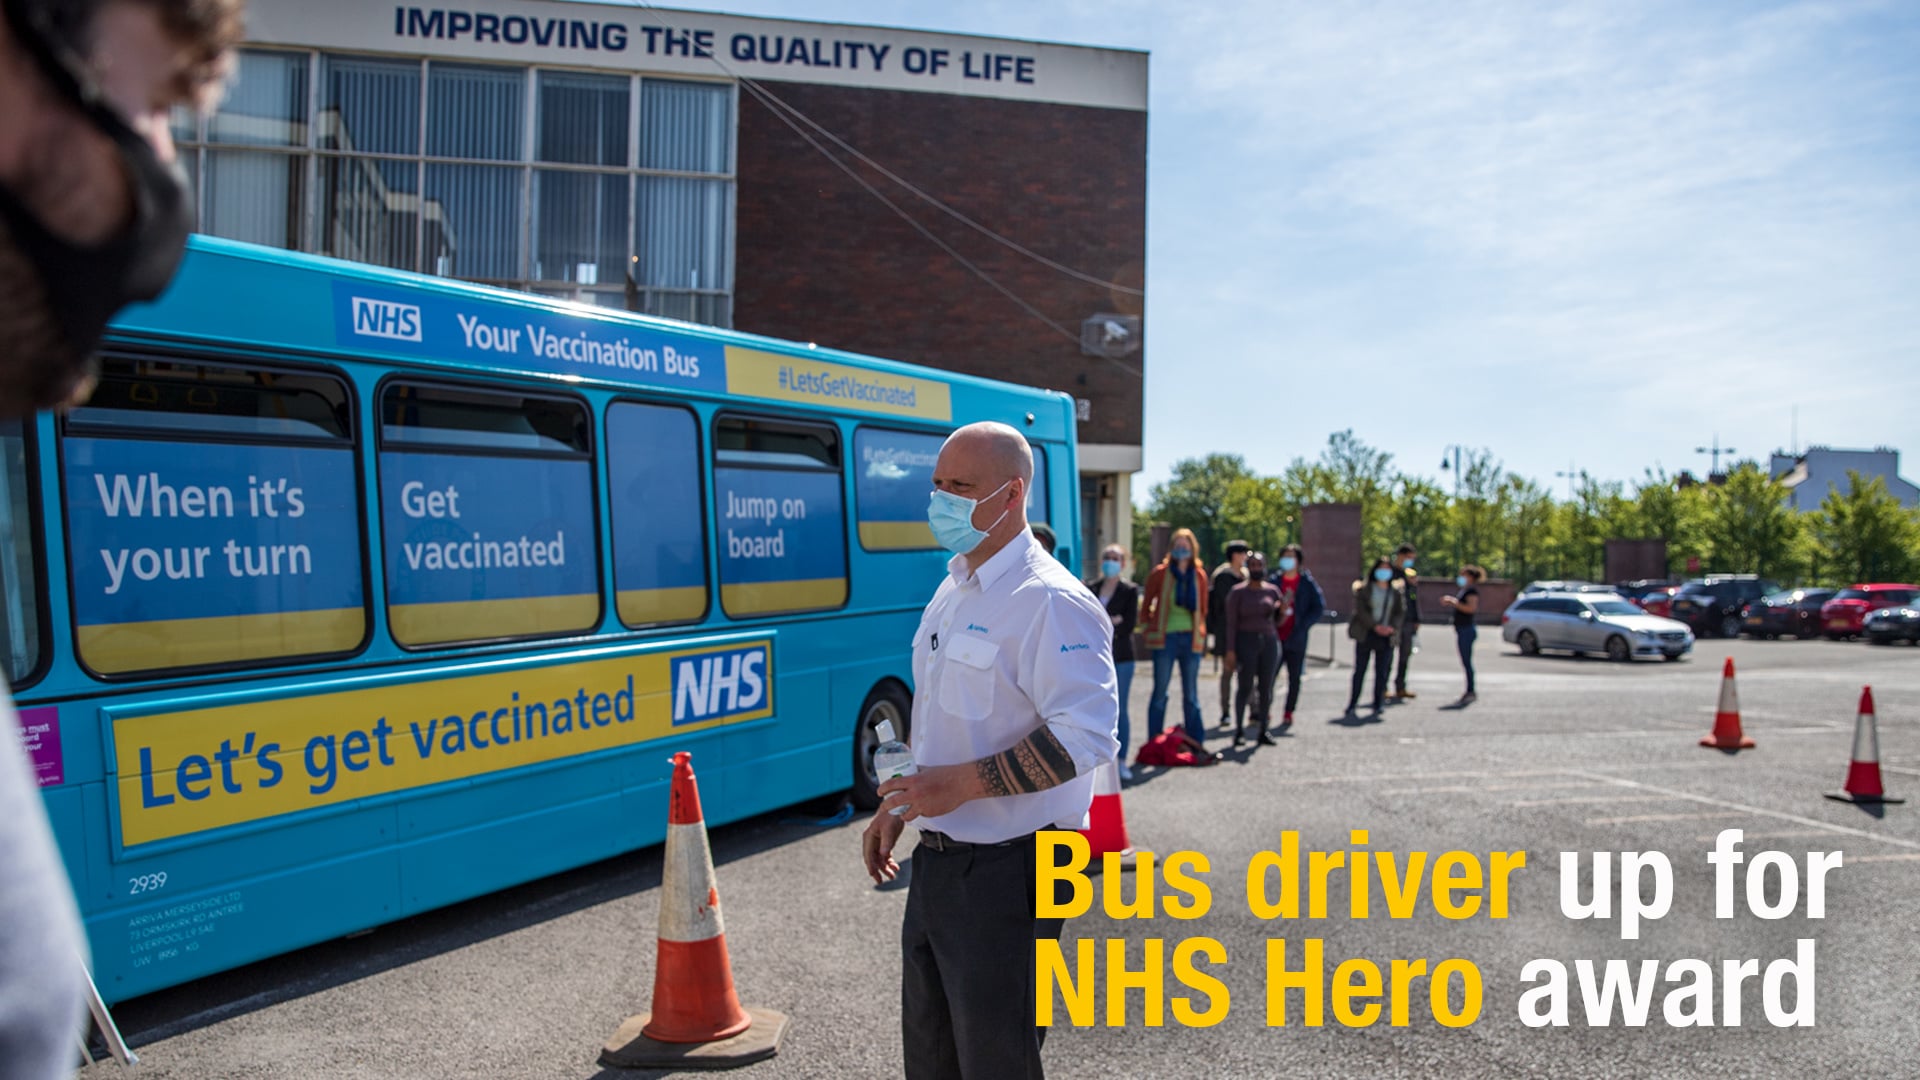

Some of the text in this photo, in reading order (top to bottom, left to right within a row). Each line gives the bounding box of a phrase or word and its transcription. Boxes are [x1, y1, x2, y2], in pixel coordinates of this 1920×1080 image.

[395, 7, 1036, 85] IMPROVING THE QUALITY OF LIFE
[357, 301, 419, 338] NHS
[457, 313, 700, 378] Your Vaccination Bus
[778, 366, 916, 408] #LetsGetVaccinated
[95, 473, 234, 518] When
[401, 481, 460, 520] Get
[726, 490, 806, 525] Jump on
[404, 531, 565, 571] vaccinated
[728, 528, 785, 558] board
[101, 538, 313, 594] your turn
[674, 650, 766, 718] NHS
[304, 716, 395, 793] get
[409, 674, 636, 759] vaccinated
[129, 871, 167, 894] 2939
